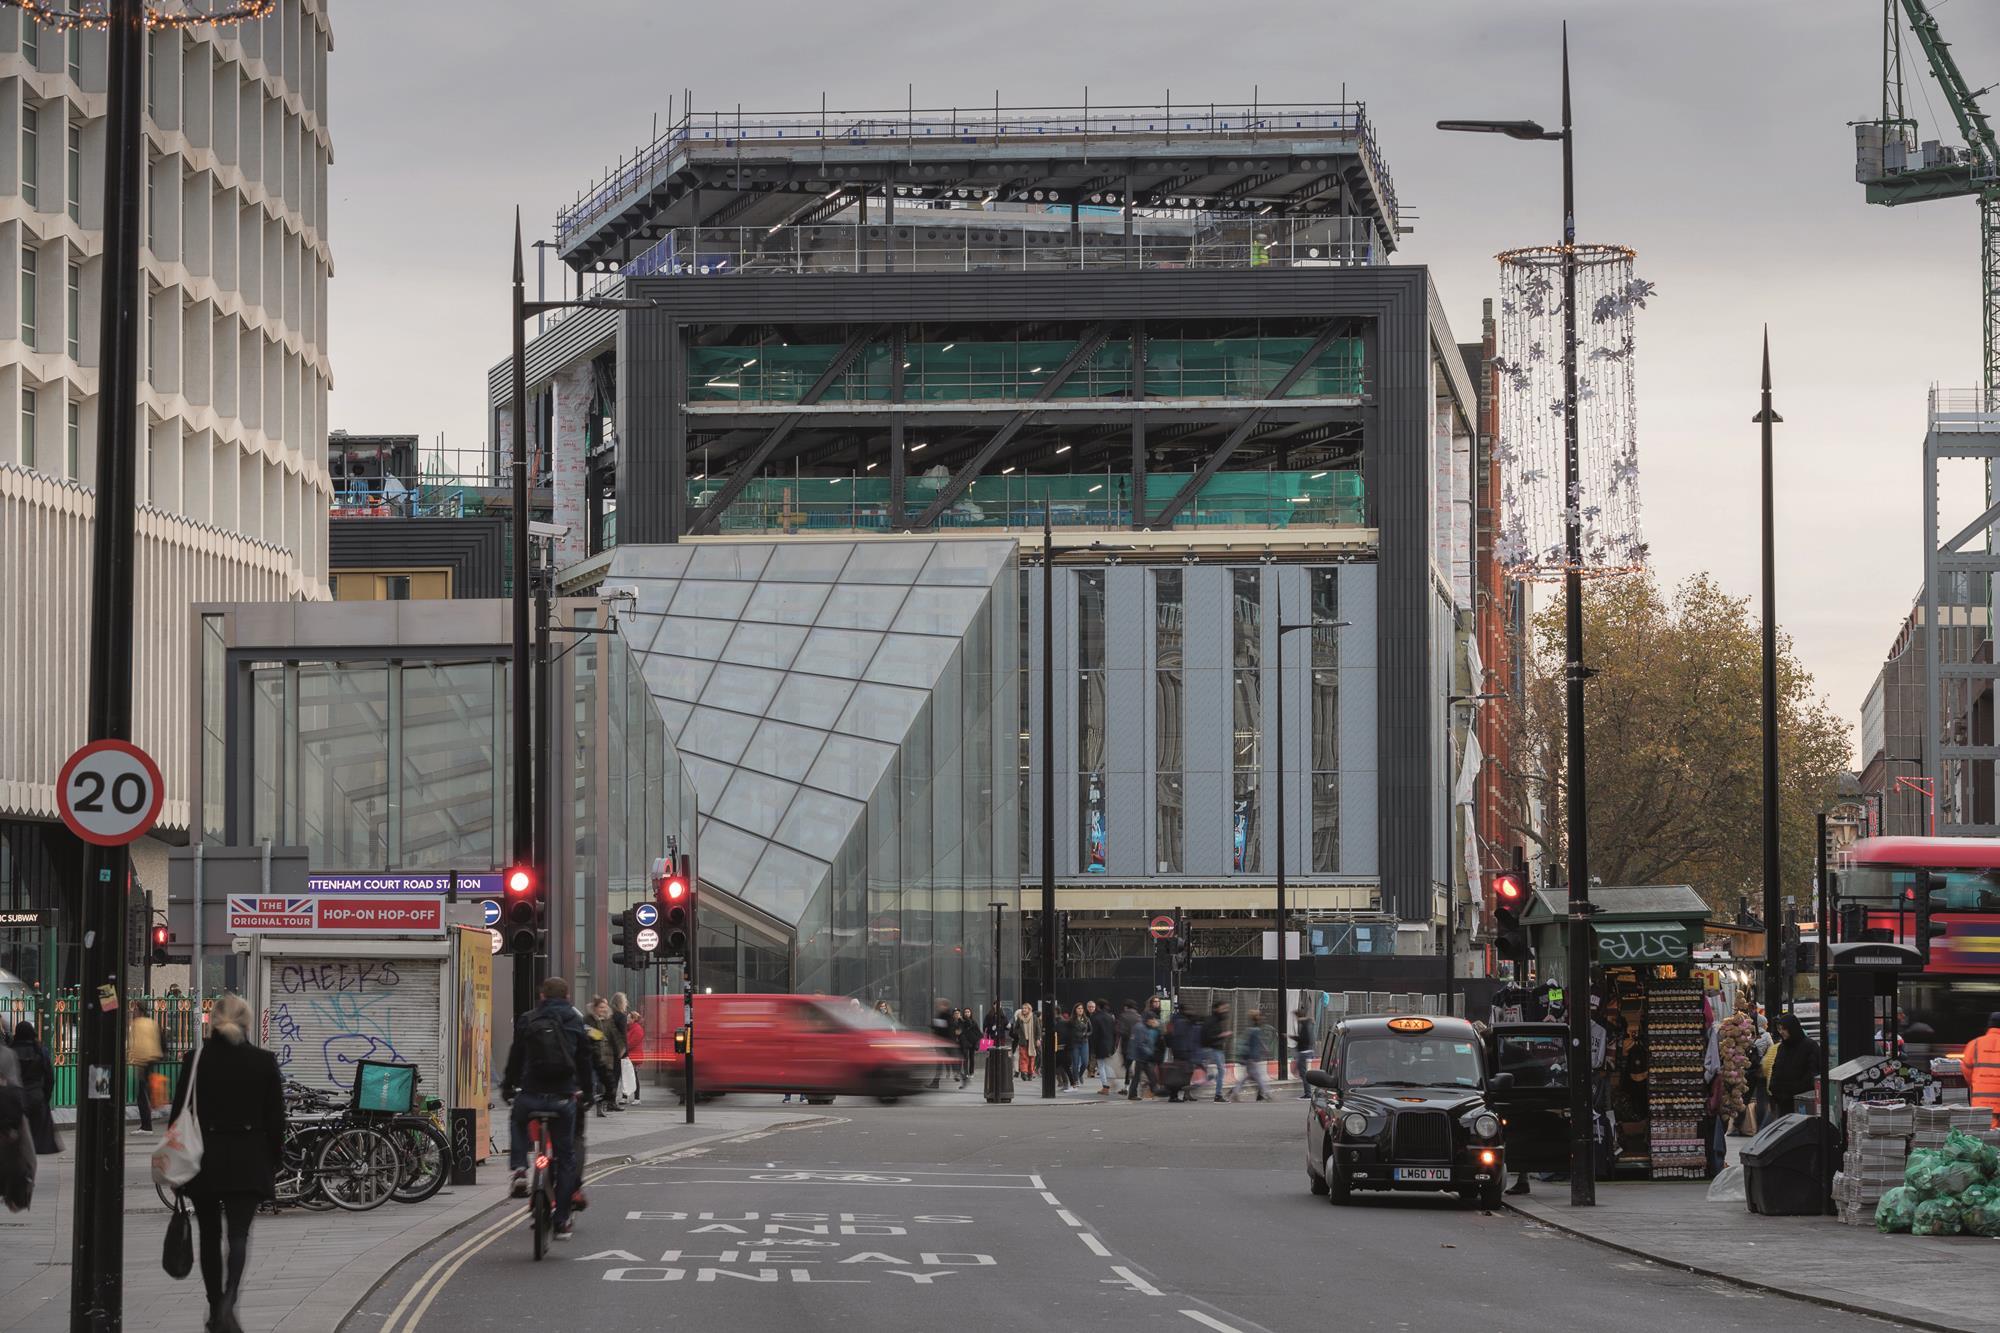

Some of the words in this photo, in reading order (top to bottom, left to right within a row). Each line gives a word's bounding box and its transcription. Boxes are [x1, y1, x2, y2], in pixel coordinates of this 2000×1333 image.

[74, 771, 146, 814] 20
[308, 880, 361, 890] TTENHAM
[363, 879, 400, 890] COURT
[403, 879, 434, 889] ROAD
[436, 879, 481, 889] STTION
[262, 901, 282, 910] THE
[8, 914, 38, 922] SUBWAY
[323, 909, 375, 920] HOP-ON
[378, 909, 435, 921] HOP-OFF
[233, 917, 282, 926] ORIGINAL
[283, 917, 311, 926] TOUR
[1398, 1020, 1425, 1029] TAXI
[1400, 1169, 1427, 1179] LM60
[625, 1210, 975, 1224] BUSES
[686, 1223, 908, 1236] AND
[574, 1249, 998, 1266] AHEAD
[602, 1267, 959, 1284] ONLY
